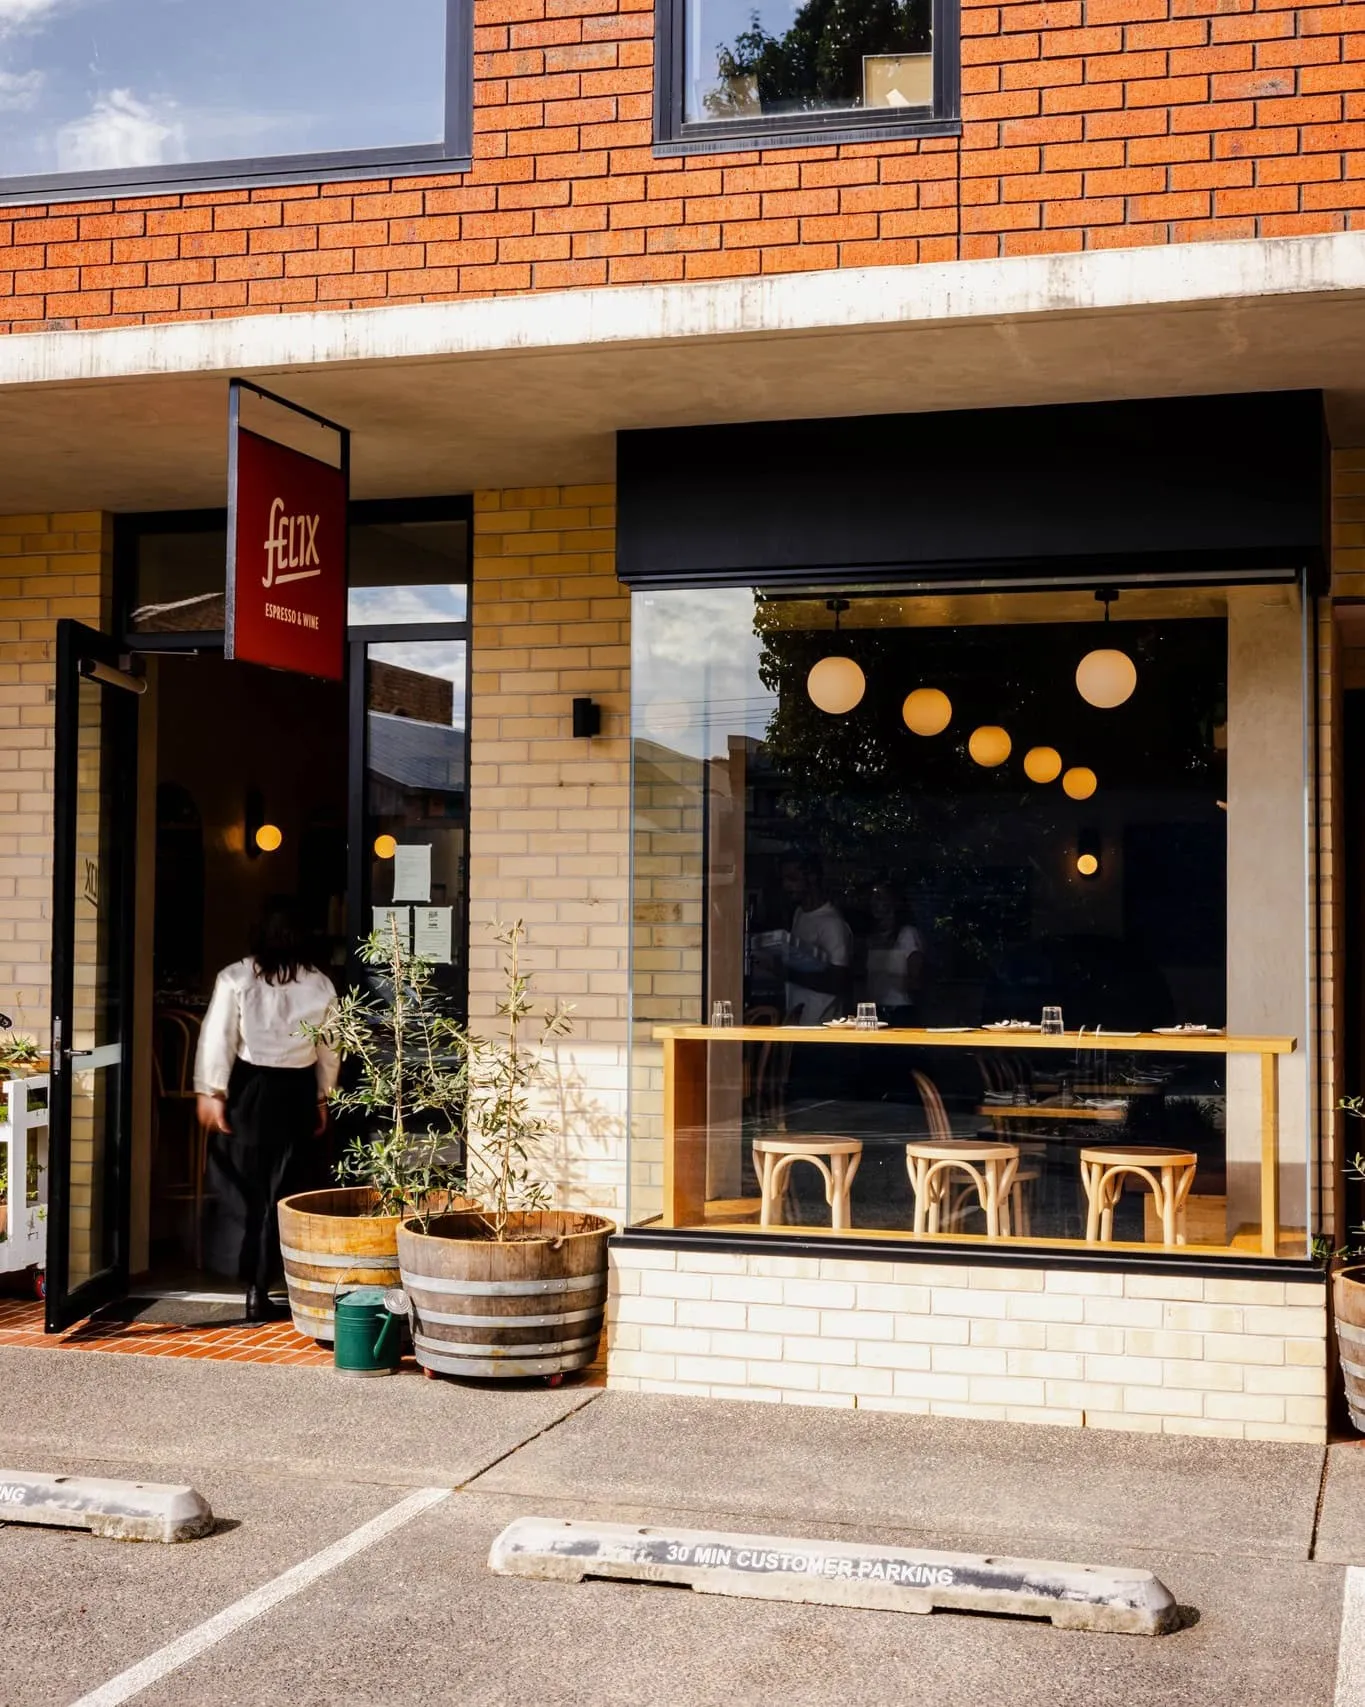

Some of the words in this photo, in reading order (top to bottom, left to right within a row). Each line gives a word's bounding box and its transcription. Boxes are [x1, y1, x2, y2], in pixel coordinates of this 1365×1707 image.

[265, 602, 296, 624] ESPRESSO
[297, 611, 302, 626] &
[302, 612, 319, 630] WINE
[666, 1544, 689, 1563] 30
[693, 1546, 732, 1566] MIN
[736, 1550, 854, 1577] CUSTOMER
[857, 1560, 955, 1586] PARKING
